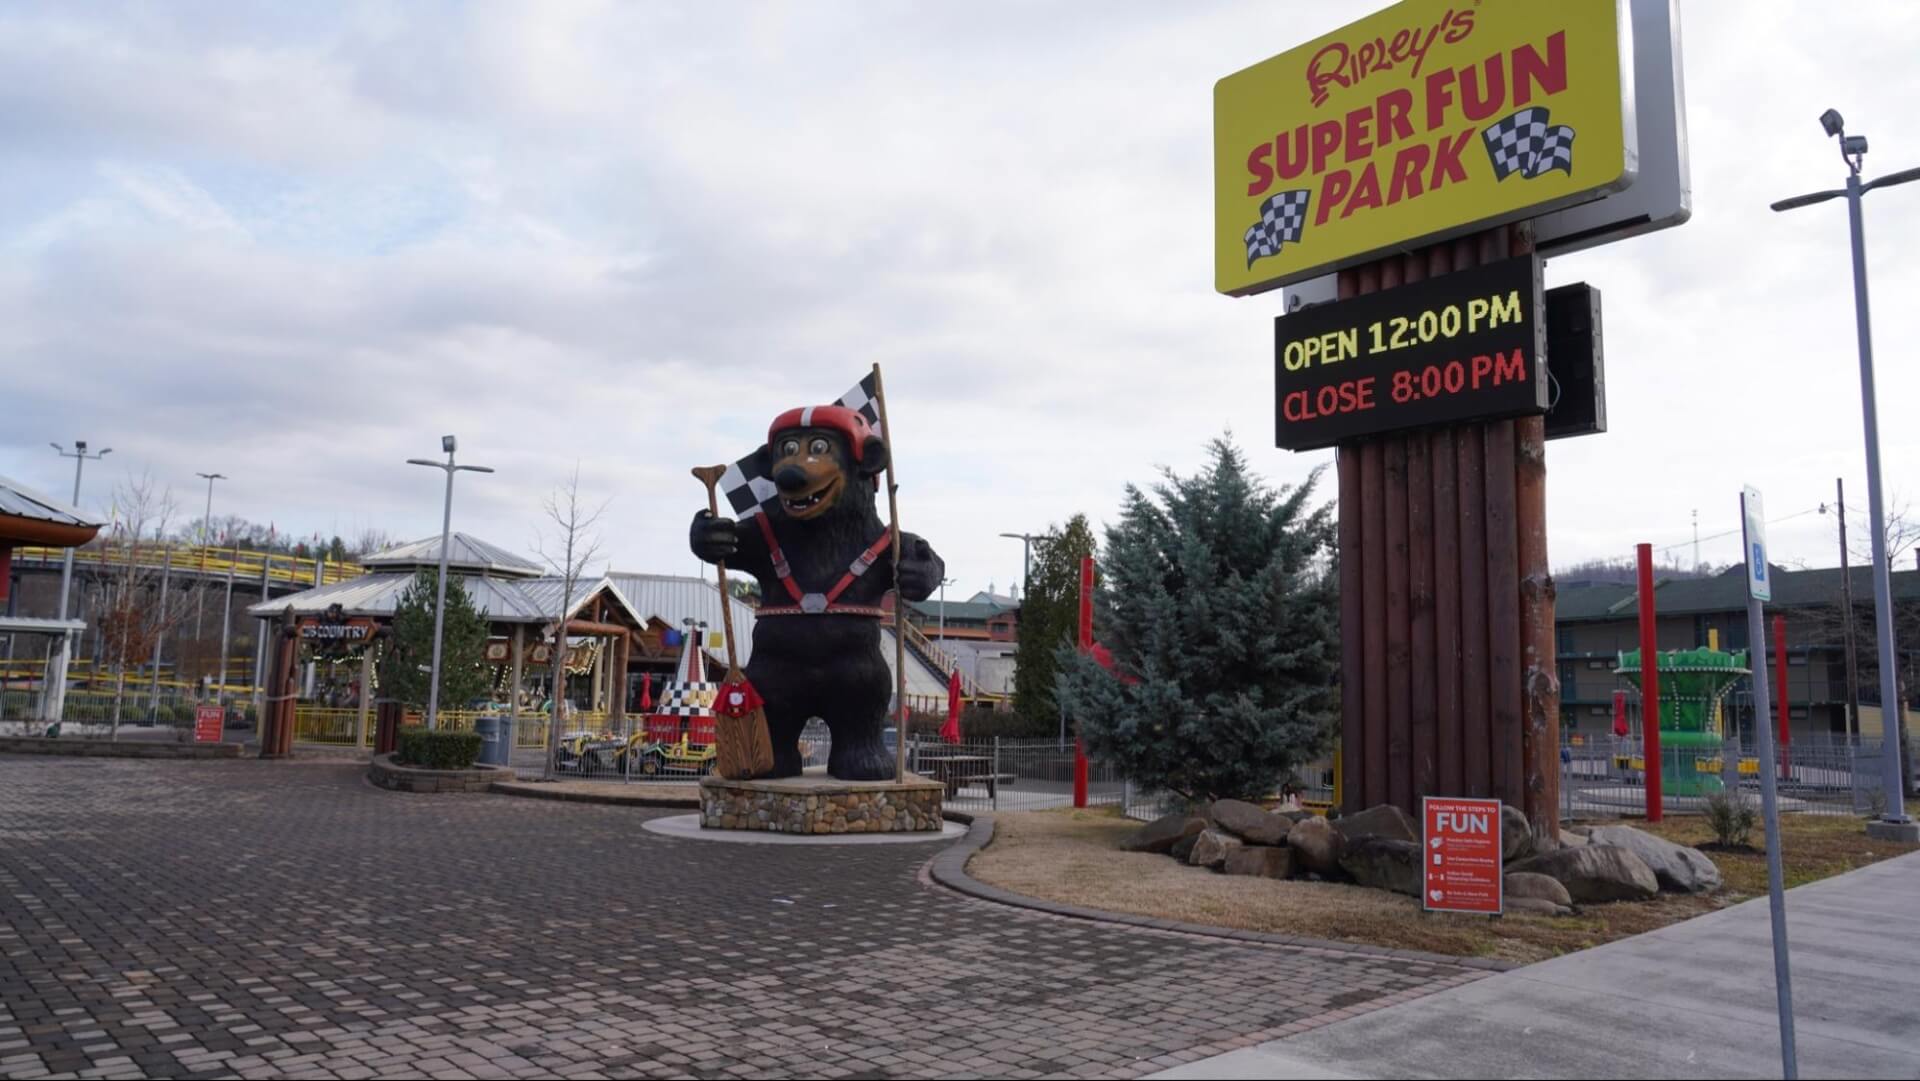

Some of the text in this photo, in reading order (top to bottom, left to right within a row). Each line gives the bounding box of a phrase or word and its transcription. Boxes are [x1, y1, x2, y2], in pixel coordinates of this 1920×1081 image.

[1247, 29, 1568, 197] SUPER FUN
[1314, 127, 1477, 227] PARK
[1284, 290, 1522, 371] OPEN 12:00 PM
[1283, 348, 1526, 422] CLOSE 8:00 PM
[317, 625, 369, 639] COUNTRY
[1437, 812, 1488, 834] FUN
